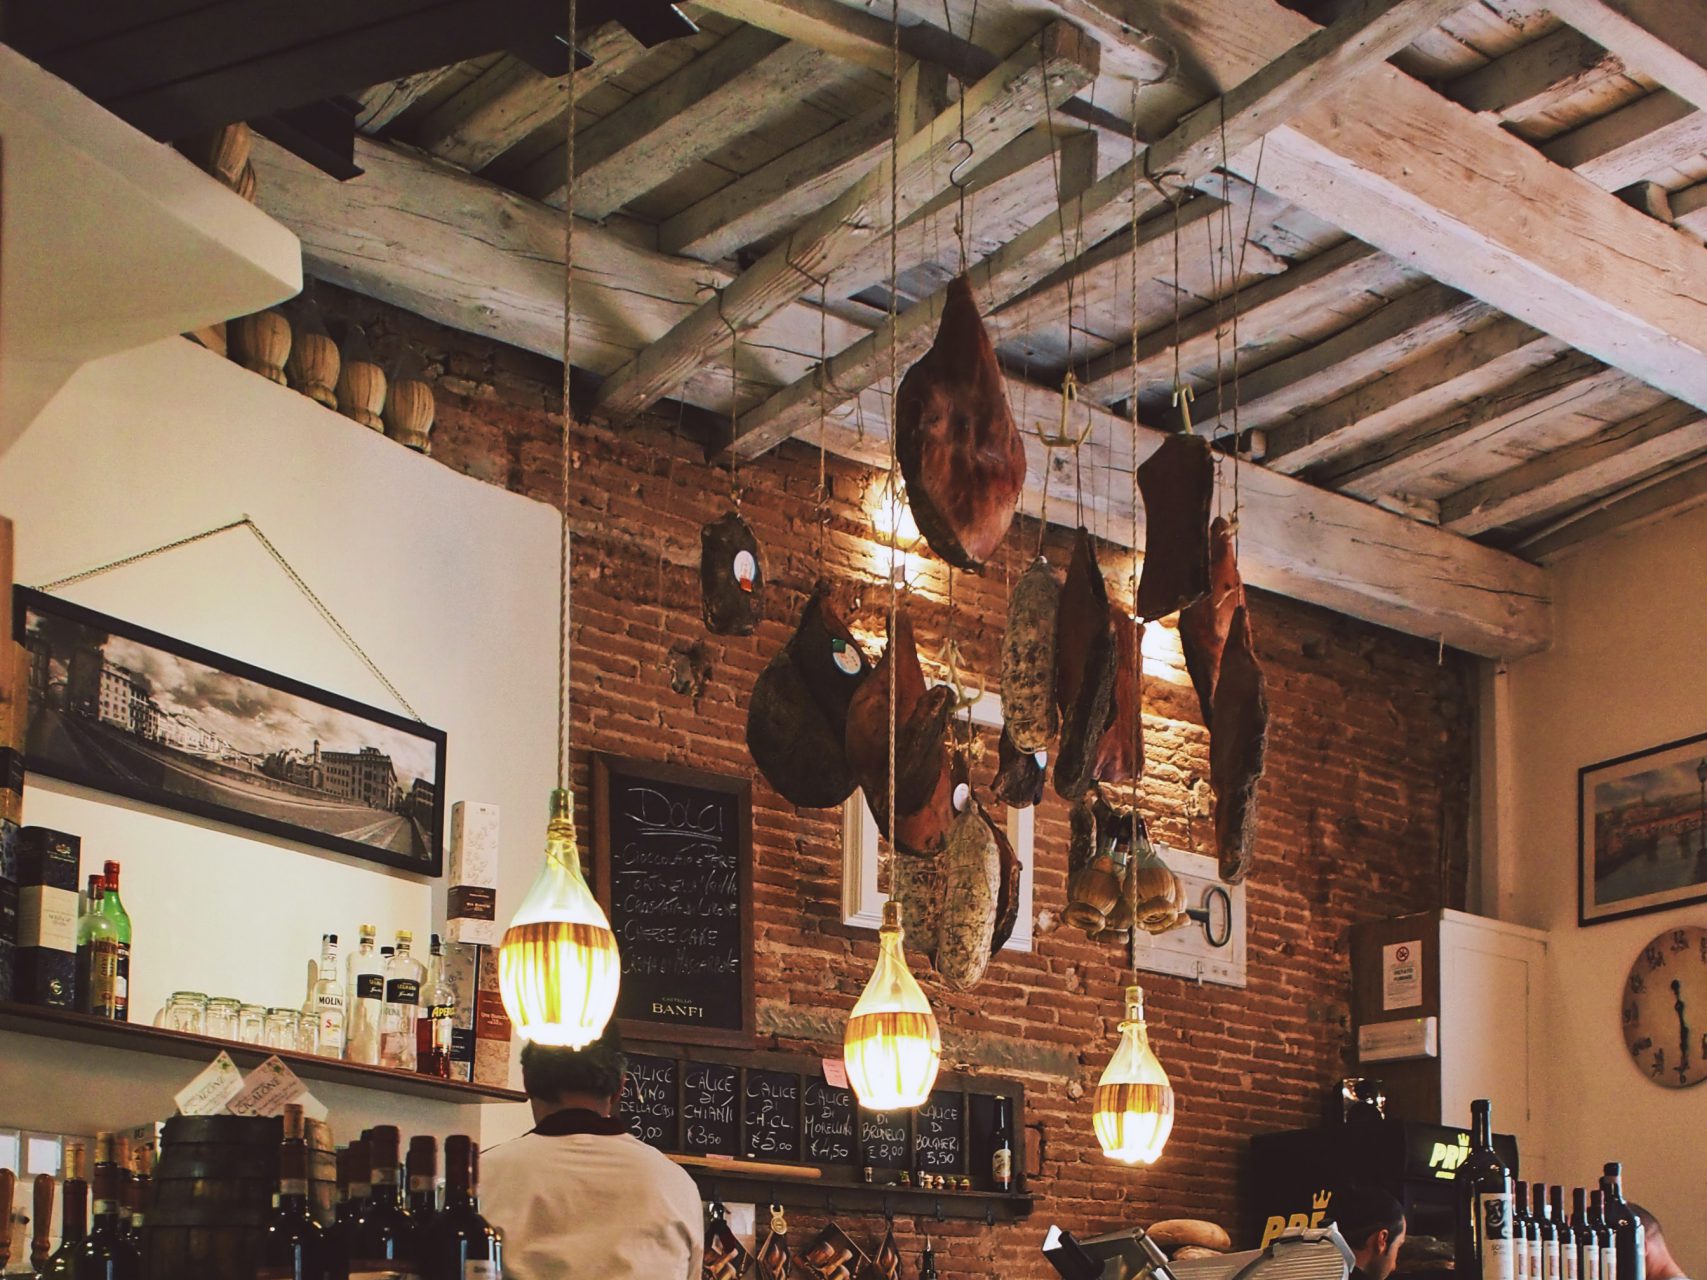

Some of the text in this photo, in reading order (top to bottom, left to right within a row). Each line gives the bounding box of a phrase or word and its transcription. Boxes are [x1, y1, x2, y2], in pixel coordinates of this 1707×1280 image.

[652, 1002, 703, 1018] BANFI
[685, 1069, 735, 1093] CALICE
[746, 1075, 797, 1100] CALICE
[621, 1086, 633, 1098] DI
[804, 1082, 850, 1107] CALICE
[620, 1101, 650, 1113] DELLA
[918, 1104, 958, 1121] CALICE
[876, 1111, 889, 1125] DI
[631, 1115, 663, 1141] 3,00
[930, 1120, 943, 1133] DI
[926, 1151, 955, 1166] 5,50
